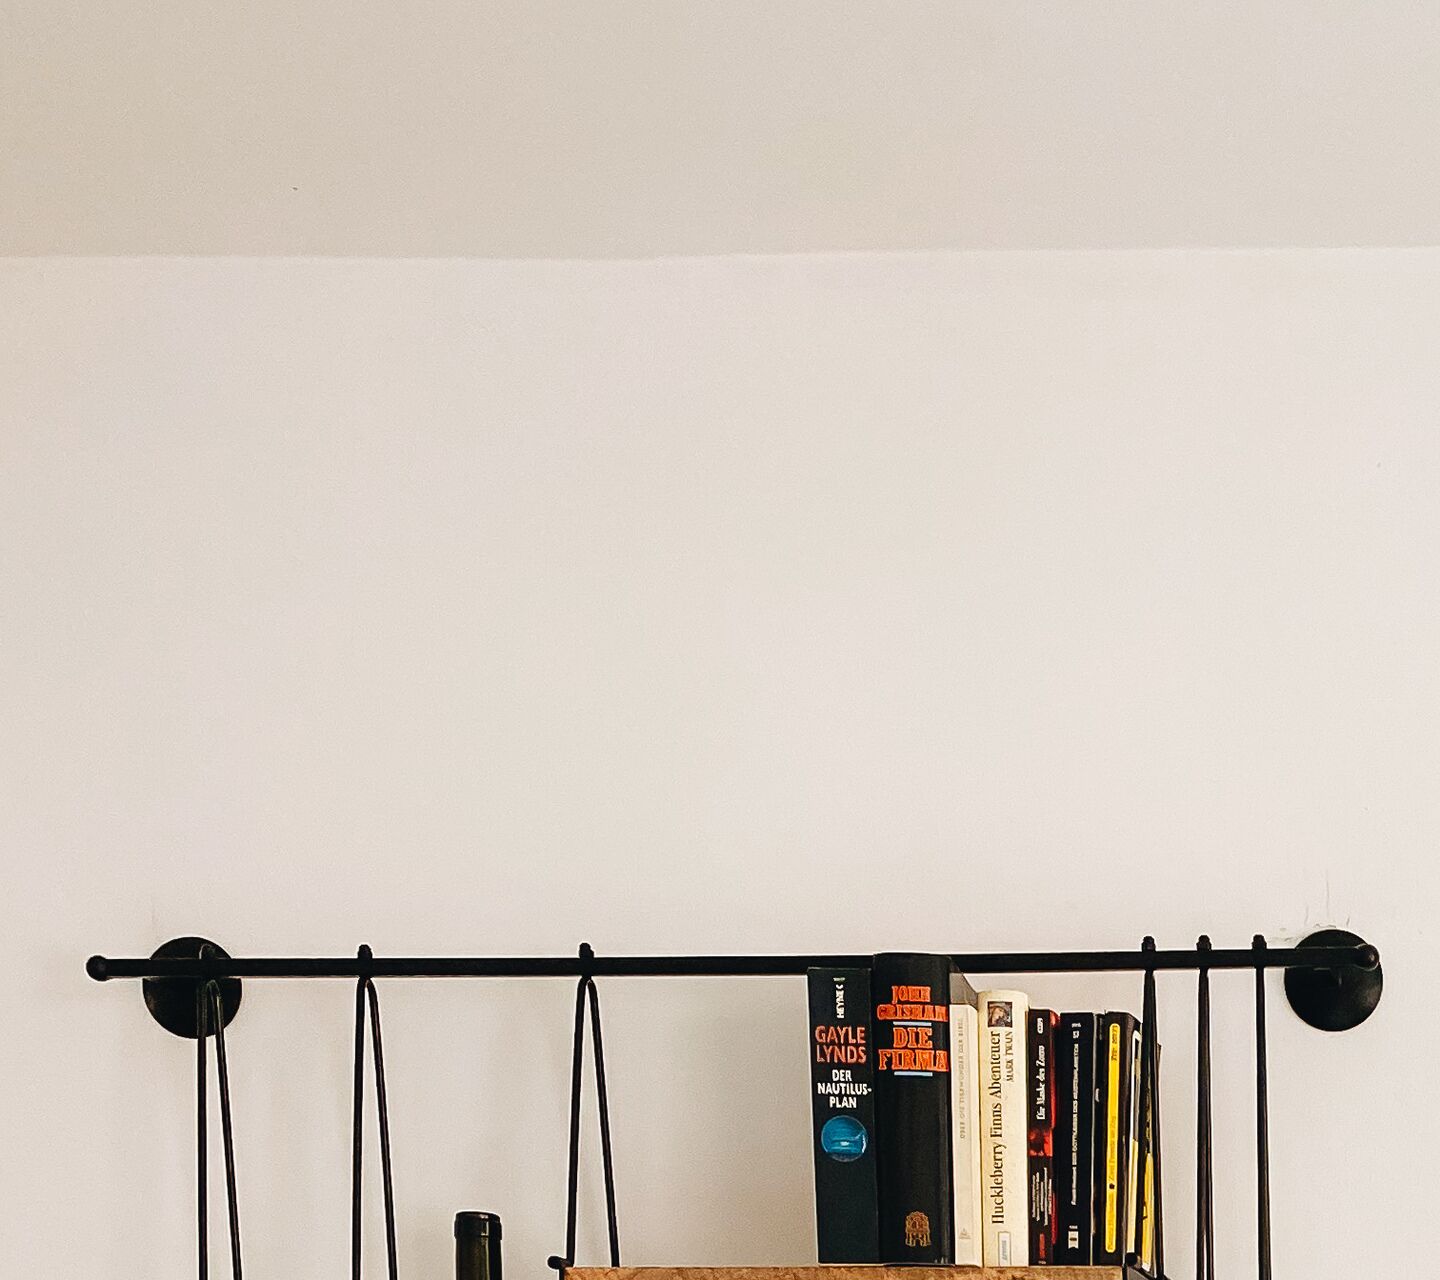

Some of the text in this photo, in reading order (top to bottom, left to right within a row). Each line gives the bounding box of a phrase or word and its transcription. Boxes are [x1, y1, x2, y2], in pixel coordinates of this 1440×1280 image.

[891, 985, 931, 1003] JOHN
[876, 1003, 948, 1022] GRISHAM
[815, 1025, 867, 1044] GAYLE
[893, 1026, 933, 1049] DIE
[816, 1045, 867, 1064] LYNDS
[878, 1049, 949, 1072] FIRMA
[1005, 1030, 1014, 1083] MARK TWAIN
[989, 1030, 1002, 1099] Abenteuer
[831, 1069, 853, 1082] DER
[817, 1082, 873, 1096] NAUTILUS-
[829, 1095, 858, 1109] PLAN
[990, 1103, 1003, 1138] Finns
[991, 1142, 1006, 1224] Huckleberry
